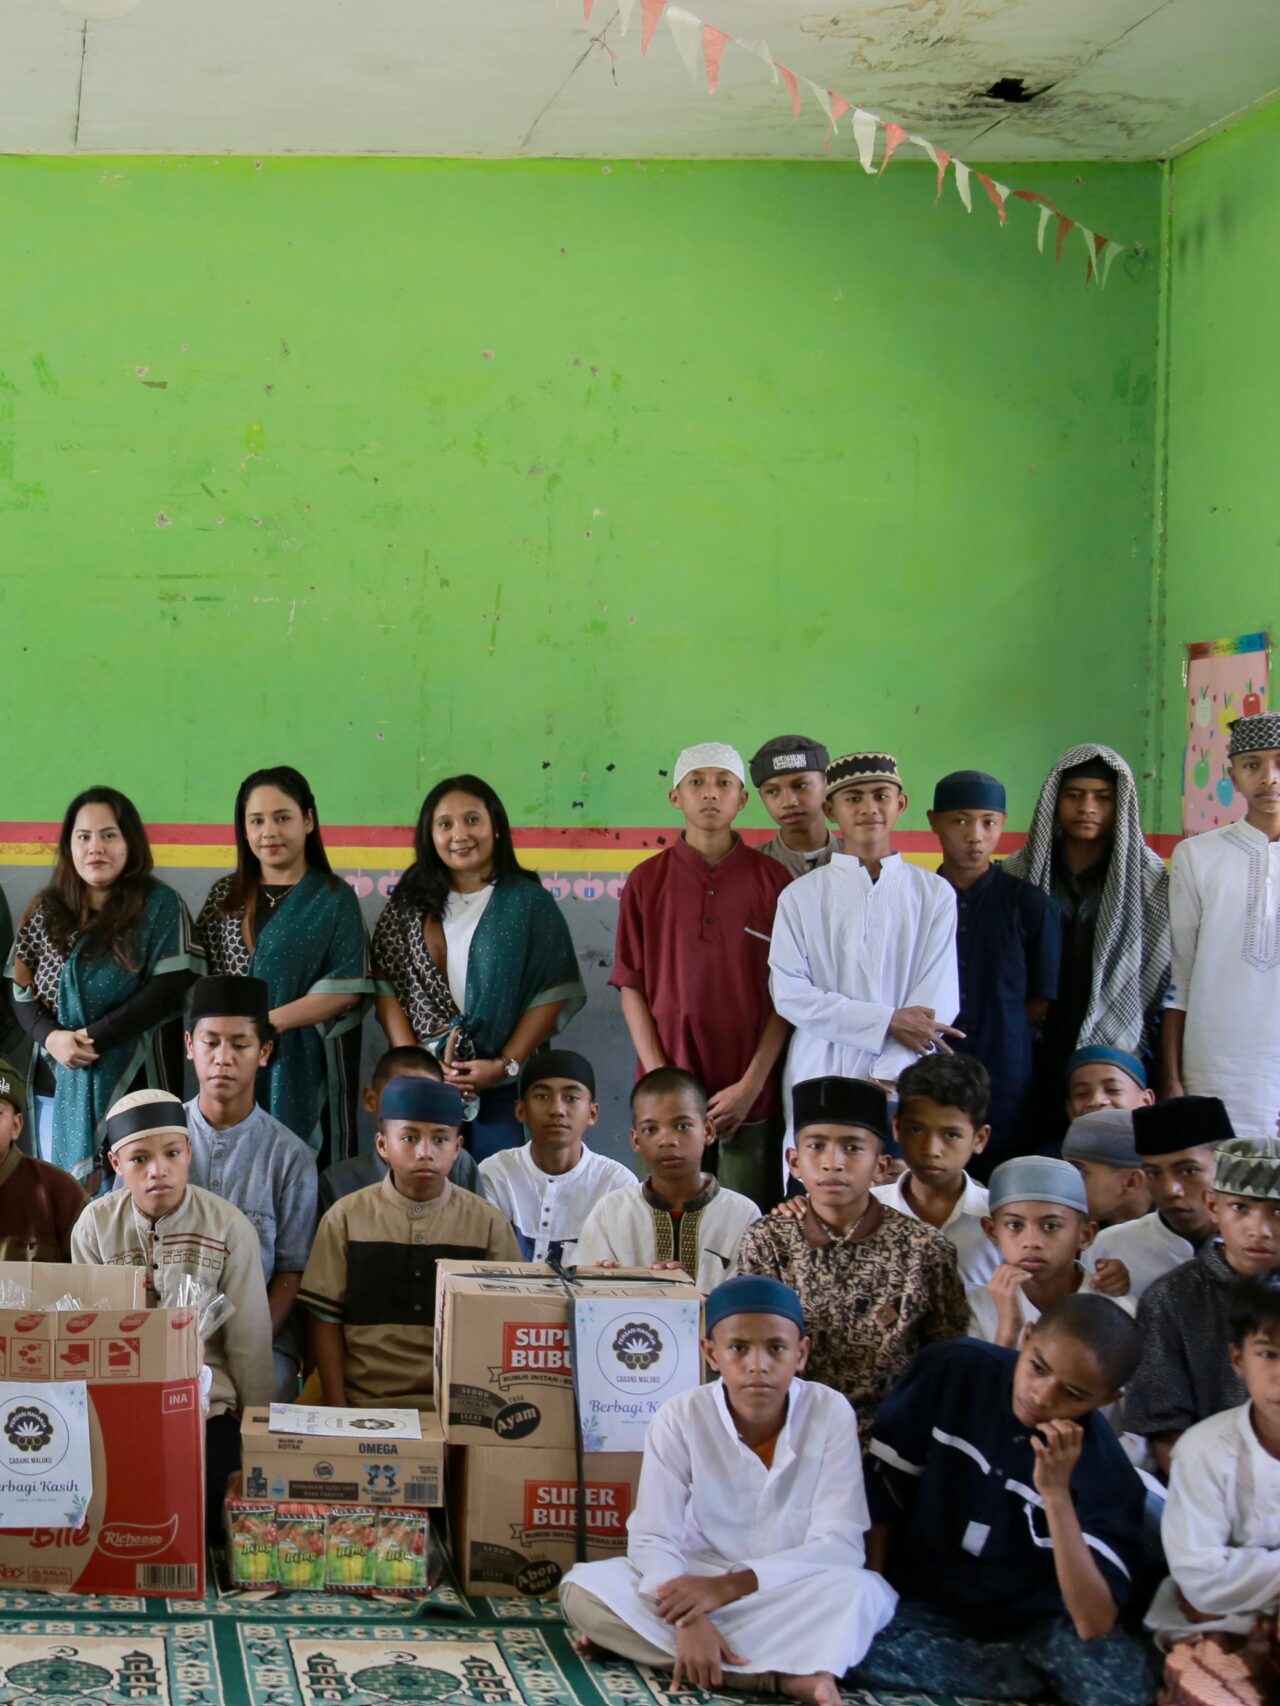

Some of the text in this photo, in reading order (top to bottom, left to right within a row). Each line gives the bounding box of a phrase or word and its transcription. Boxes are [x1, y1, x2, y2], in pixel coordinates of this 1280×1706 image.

[515, 1329, 569, 1346] SUP
[511, 1350, 572, 1369] BUB
[503, 1374, 529, 1382] BUBUR
[531, 1375, 558, 1383] INSTAN
[169, 1393, 188, 1405] INA
[589, 1400, 643, 1418] Berbagi
[497, 1408, 537, 1433] Ayam
[358, 1443, 398, 1455] OMEGA
[9, 1457, 30, 1465] CABANG
[39, 1480, 79, 1493] Kasih
[104, 1531, 163, 1546] Richeese
[517, 1563, 557, 1585] Abon
